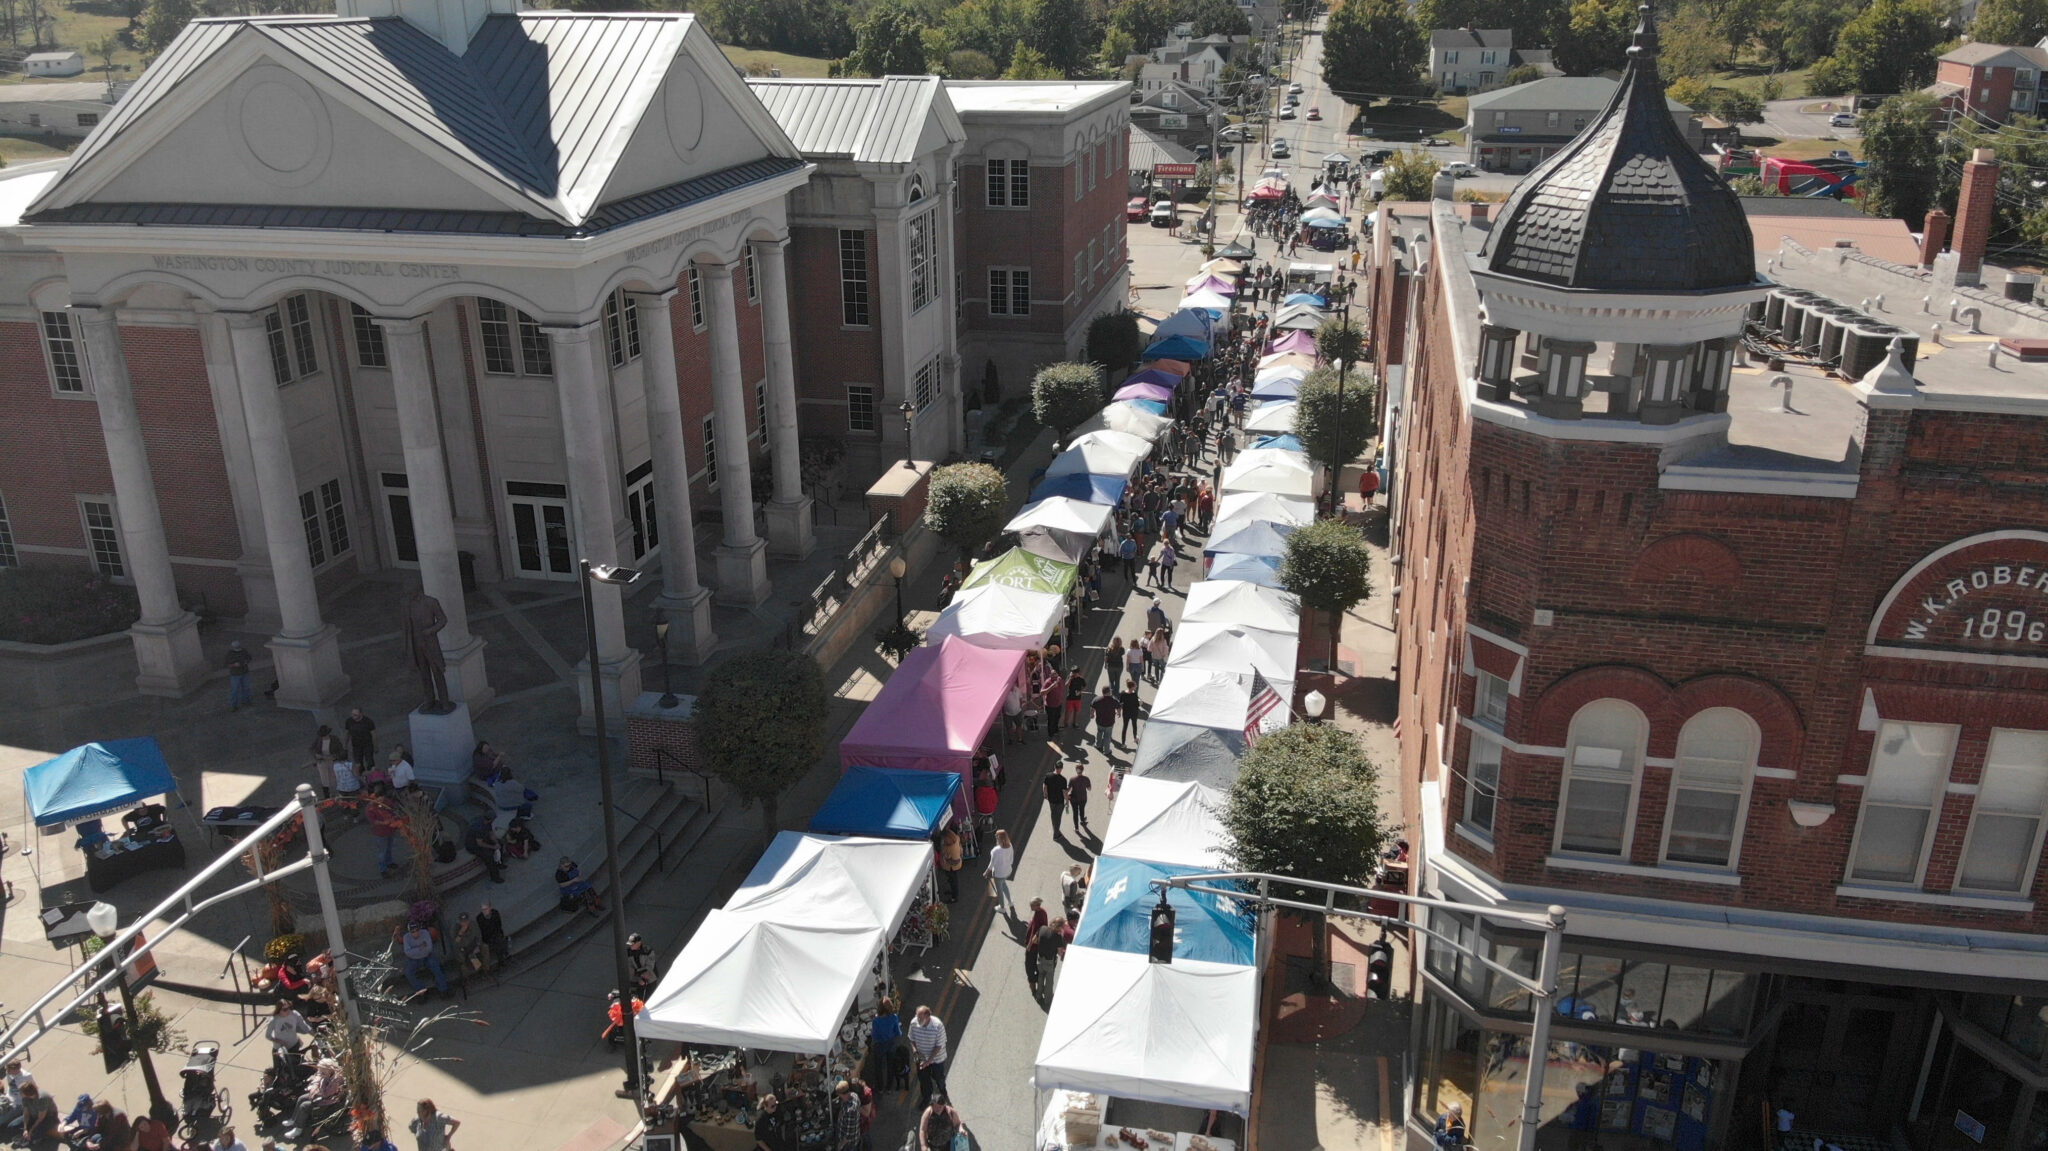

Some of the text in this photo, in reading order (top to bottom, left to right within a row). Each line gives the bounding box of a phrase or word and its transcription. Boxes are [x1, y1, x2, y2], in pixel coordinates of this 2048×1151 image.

[1157, 165, 1193, 173] Firestone
[152, 255, 462, 280] WASHINGTON COUNTY JUDICIAL CENTER
[988, 573, 1034, 589] KORT
[1963, 607, 2046, 642] 1896
[68, 800, 139, 824] INFORMATION
